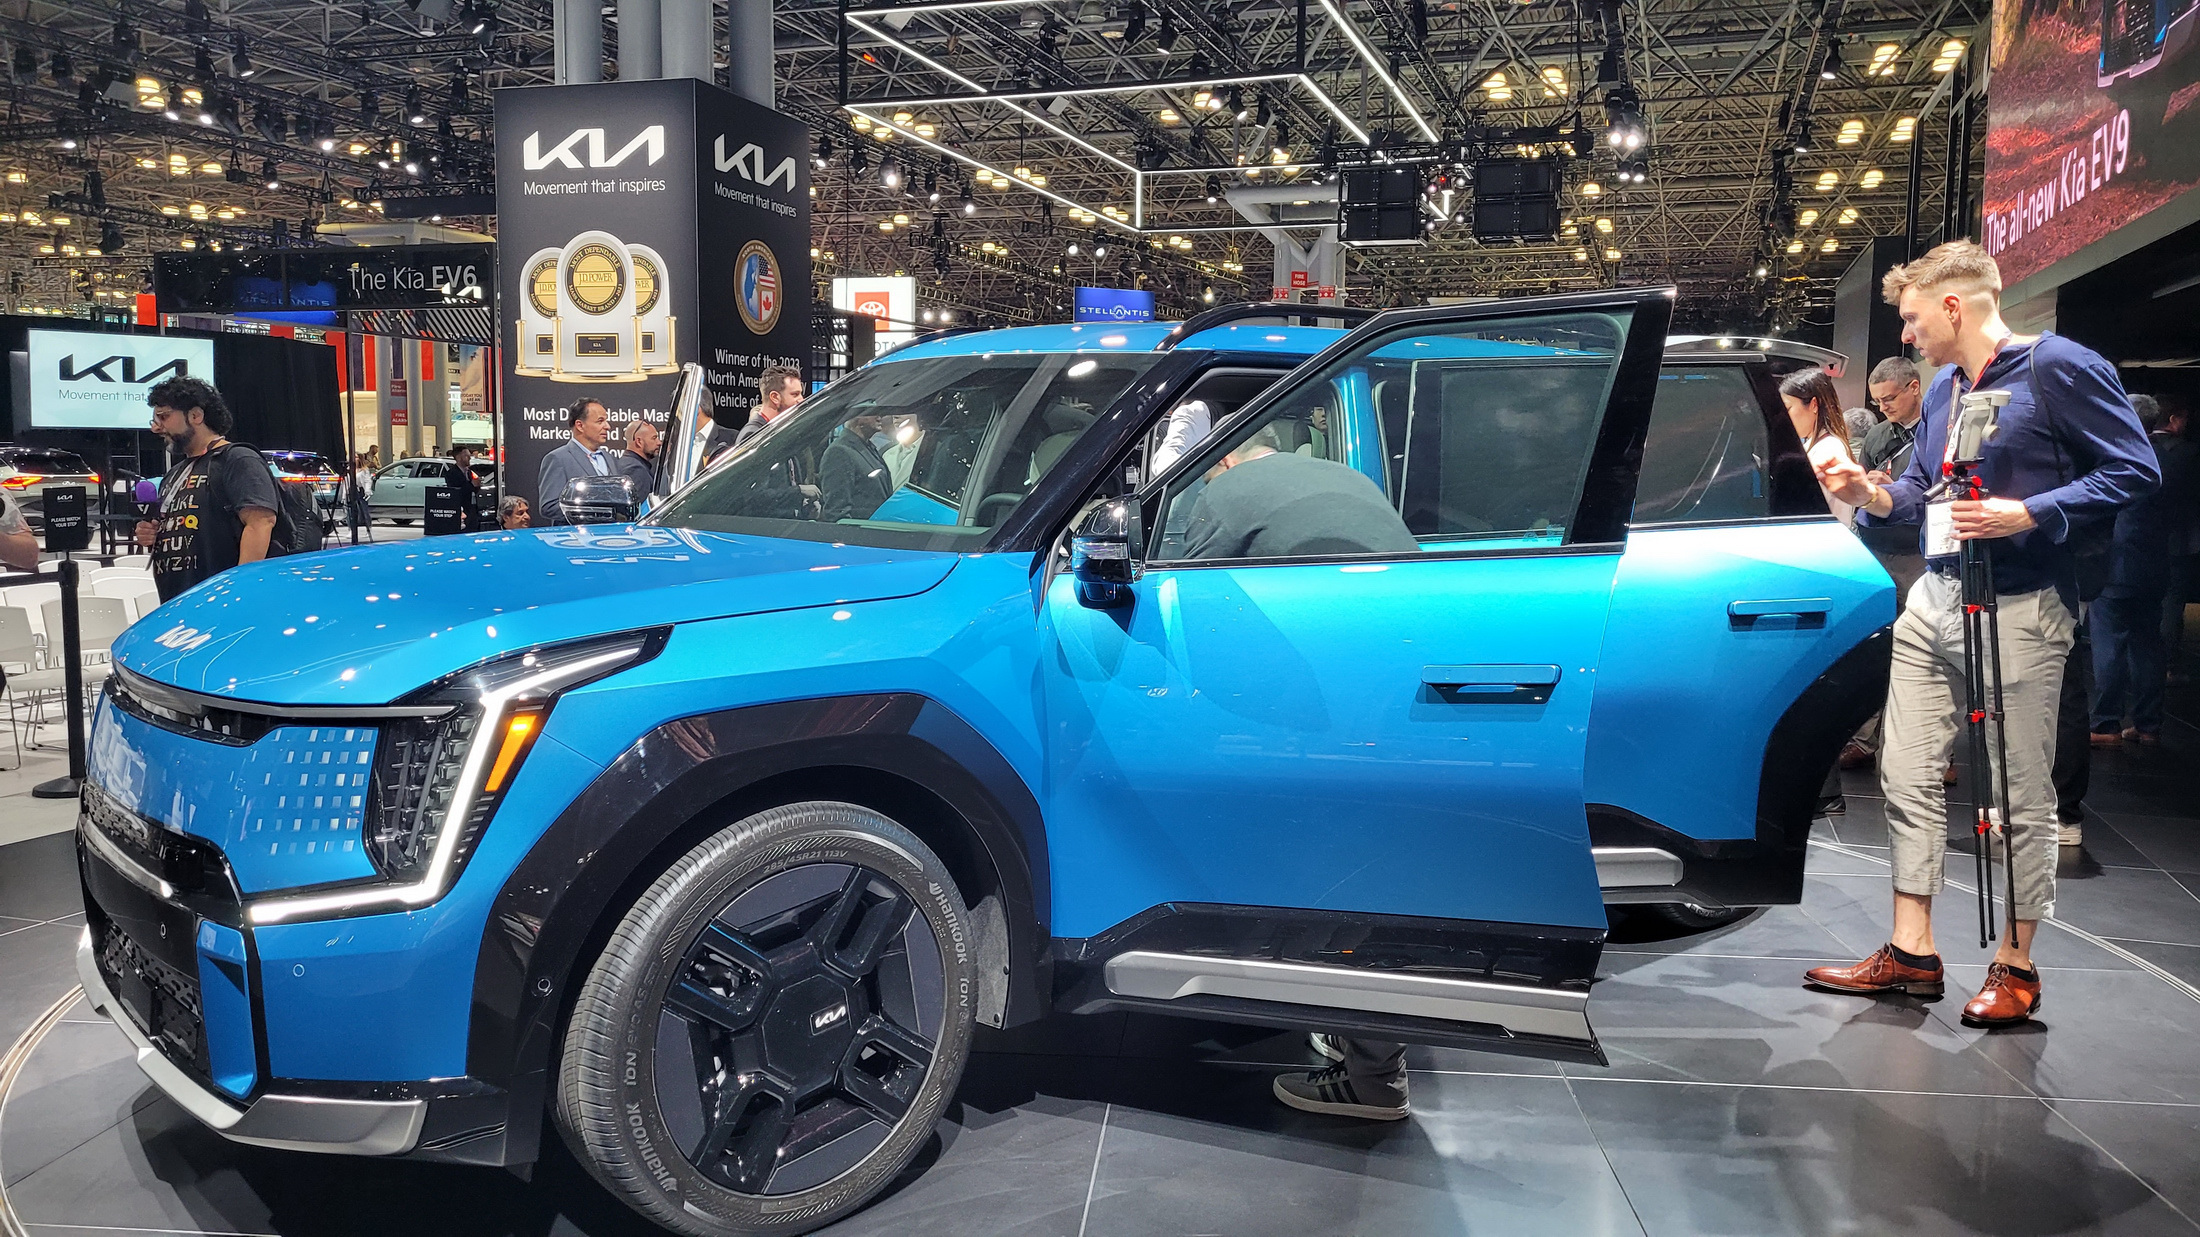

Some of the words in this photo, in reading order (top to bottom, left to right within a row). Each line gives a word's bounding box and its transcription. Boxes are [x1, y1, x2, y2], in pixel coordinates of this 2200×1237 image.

[523, 125, 665, 170] KIA
[714, 133, 796, 193] KIA
[524, 180, 588, 196] Movement
[591, 178, 616, 193] that
[619, 178, 666, 195] inspires
[1987, 211, 2007, 256] The
[2009, 177, 2058, 246] all-new
[2059, 147, 2086, 212] Kia
[2091, 108, 2130, 192] EV9
[714, 181, 754, 205] Movement
[755, 195, 770, 210] that
[771, 199, 797, 217] inspires
[570, 251, 584, 269] MOST
[584, 247, 621, 269] DEPENDABLE
[347, 267, 386, 290] The
[393, 266, 424, 290] Kia
[432, 265, 477, 289] EV6
[1079, 306, 1150, 316] STELLANTIS
[59, 354, 188, 383] KIA
[715, 348, 749, 367] Winner
[751, 353, 761, 368] of
[763, 355, 777, 369] the
[779, 356, 800, 370] 2023
[708, 369, 736, 386] North
[738, 372, 763, 388] Amer
[59, 389, 119, 400] Movement
[123, 391, 146, 401] that
[713, 391, 747, 408] Vehicle
[750, 394, 759, 409] of
[523, 407, 556, 421] Most
[560, 408, 639, 422] Ddable
[643, 408, 670, 422] Mas
[530, 426, 573, 440] Marke
[154, 624, 212, 652] KIA
[763, 850, 821, 874] 285/45R21
[824, 850, 849, 859] 113V
[815, 1006, 846, 1028] KIA
